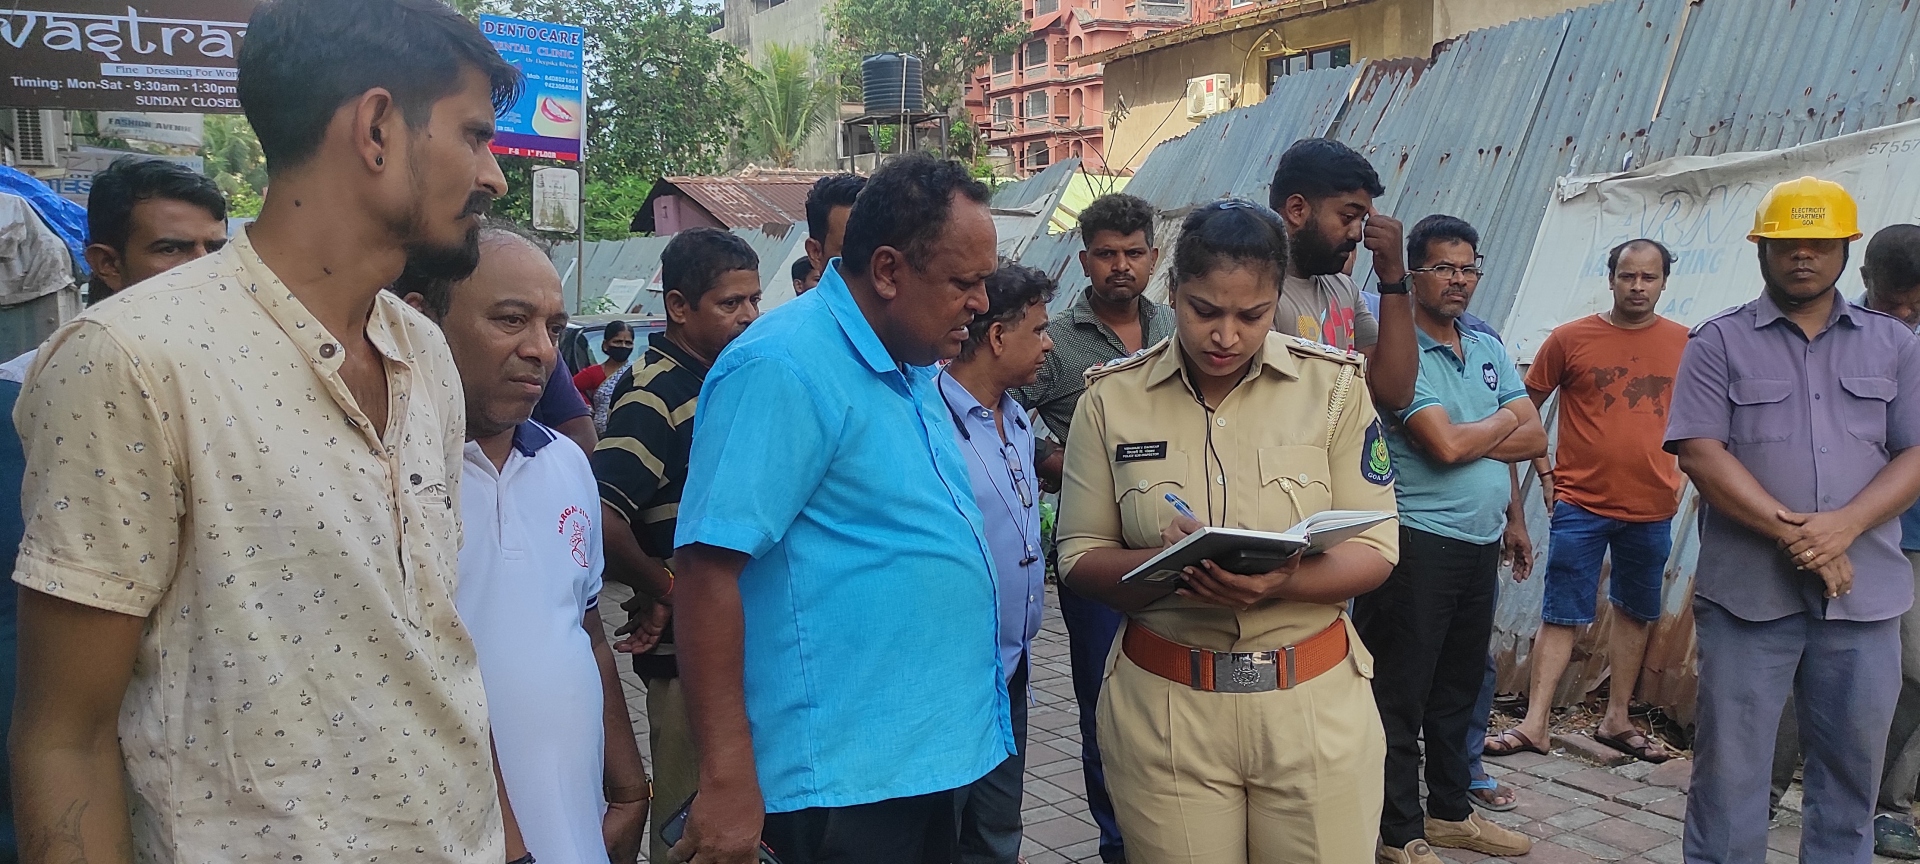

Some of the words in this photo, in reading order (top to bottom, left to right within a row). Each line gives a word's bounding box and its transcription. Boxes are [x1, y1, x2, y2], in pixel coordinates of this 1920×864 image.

[482, 20, 580, 46] DENTOCARE
[537, 47, 575, 60] CLINIC
[115, 65, 139, 74] Fine
[146, 66, 192, 77] Dressing
[195, 69, 212, 77] For
[10, 76, 63, 90] Timing:
[66, 78, 123, 90] Mon-Sat
[133, 80, 180, 92] 9:30am
[191, 82, 237, 95] 1:30pm
[135, 95, 187, 107] SUNDAY
[191, 97, 241, 108] CLOSED
[108, 117, 151, 128] FASHION
[155, 122, 193, 132] AVENUE
[535, 150, 557, 158] FLOOR
[1367, 472, 1382, 481] GOA
